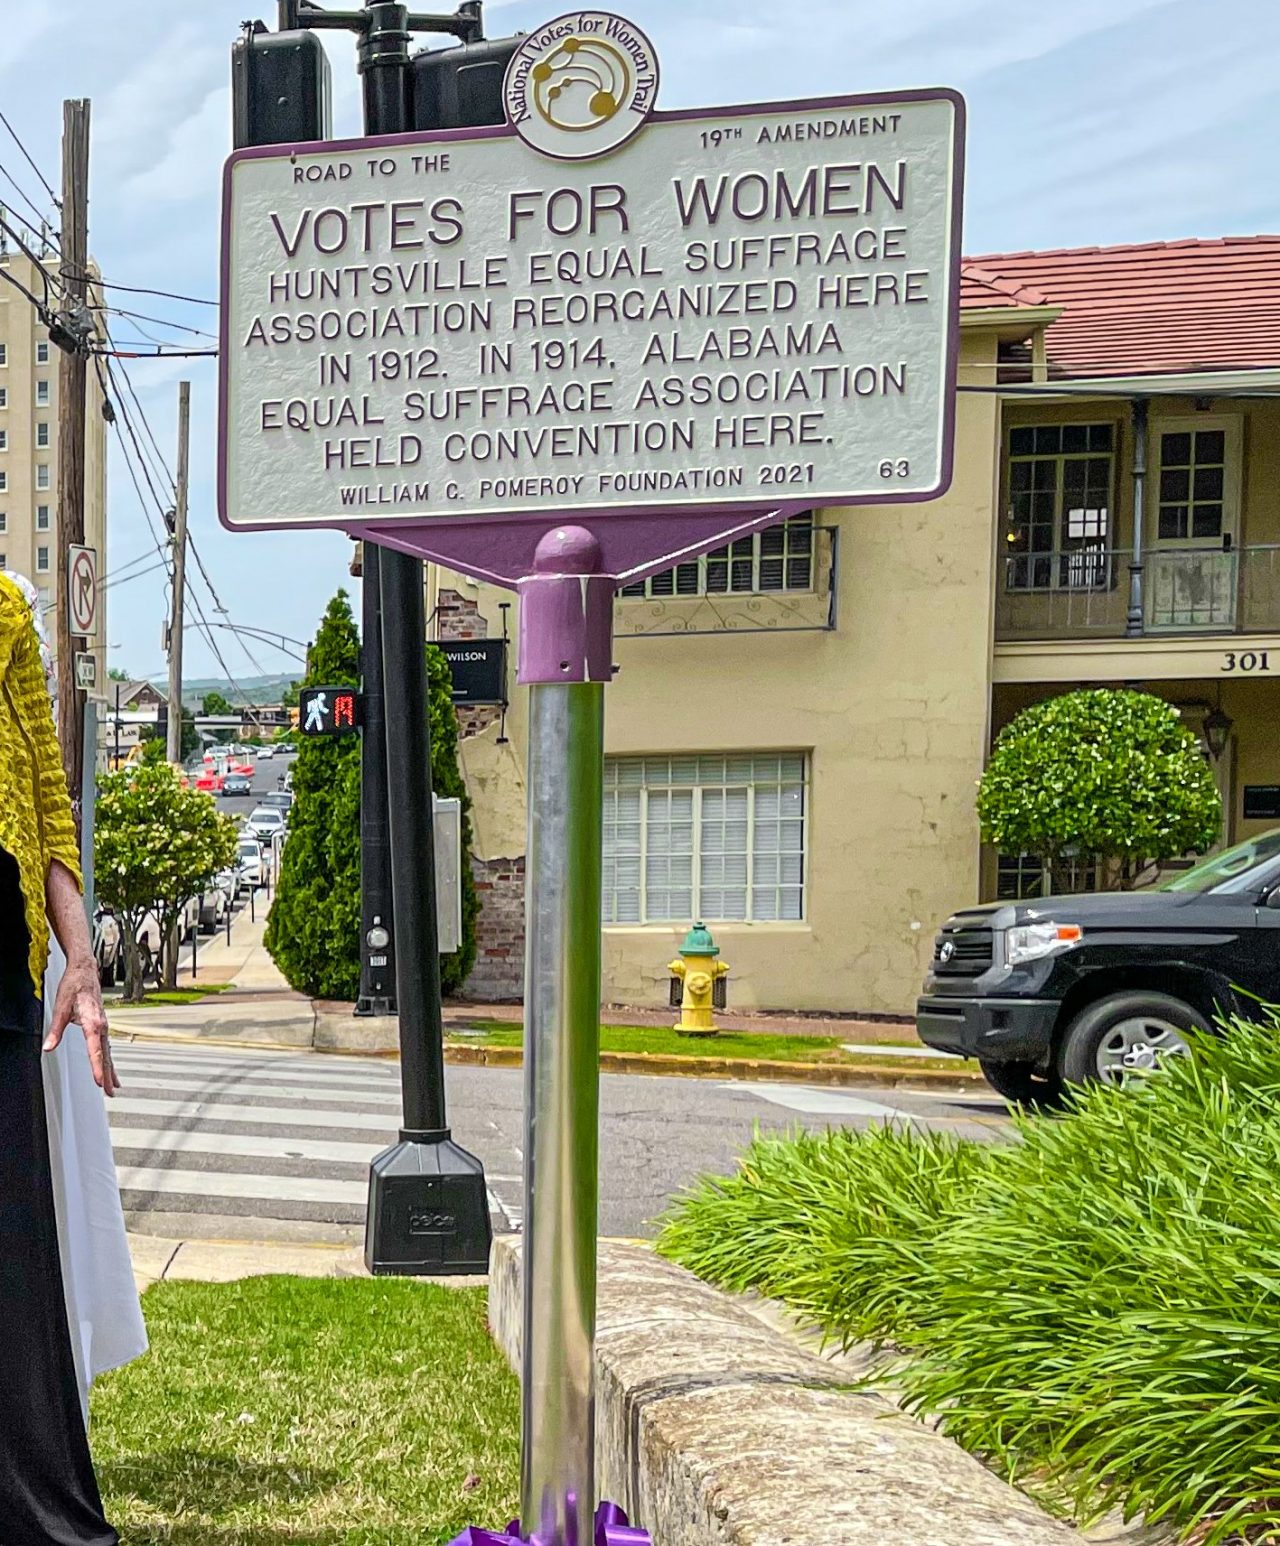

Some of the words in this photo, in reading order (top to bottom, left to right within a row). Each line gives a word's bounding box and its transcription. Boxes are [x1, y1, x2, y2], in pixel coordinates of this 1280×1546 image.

[509, 50, 535, 125] National
[527, 21, 573, 53] Votes
[577, 14, 603, 33] for
[605, 17, 651, 73] Women
[628, 74, 655, 115] Trail
[755, 115, 902, 144] AMENDMENT
[293, 163, 352, 184] ROAD
[367, 158, 397, 177] TO
[411, 154, 450, 174] THE
[270, 199, 464, 259] VOTES
[510, 185, 629, 242] FOR
[673, 160, 907, 229] WOMEN
[271, 251, 507, 303] HUNTSVILLE
[531, 247, 662, 285] EQUAL
[686, 229, 907, 274] SUFFRAGE
[245, 302, 492, 347] ASSOCIATION
[513, 281, 797, 330] REORGANIZED
[819, 272, 928, 309] HERE
[321, 354, 350, 386] IN
[369, 350, 447, 382] 1912.
[481, 344, 512, 375] IN
[531, 338, 615, 372] 1914.
[643, 324, 843, 366] ALABAMA
[262, 397, 384, 433] EQUAL
[404, 382, 613, 422] SUFFRAGE
[635, 364, 906, 410] ASSOCIATION
[326, 436, 422, 470] HELD
[445, 421, 694, 464] CONVENTION
[715, 414, 832, 449] HERE.
[880, 461, 909, 478] 63
[341, 484, 429, 505] WILLIAM
[480, 477, 583, 498] POMEROY
[600, 468, 742, 492] FOUNDATION
[761, 465, 813, 484] 2021
[447, 652, 487, 661] WILSON
[1221, 652, 1270, 672] 301
